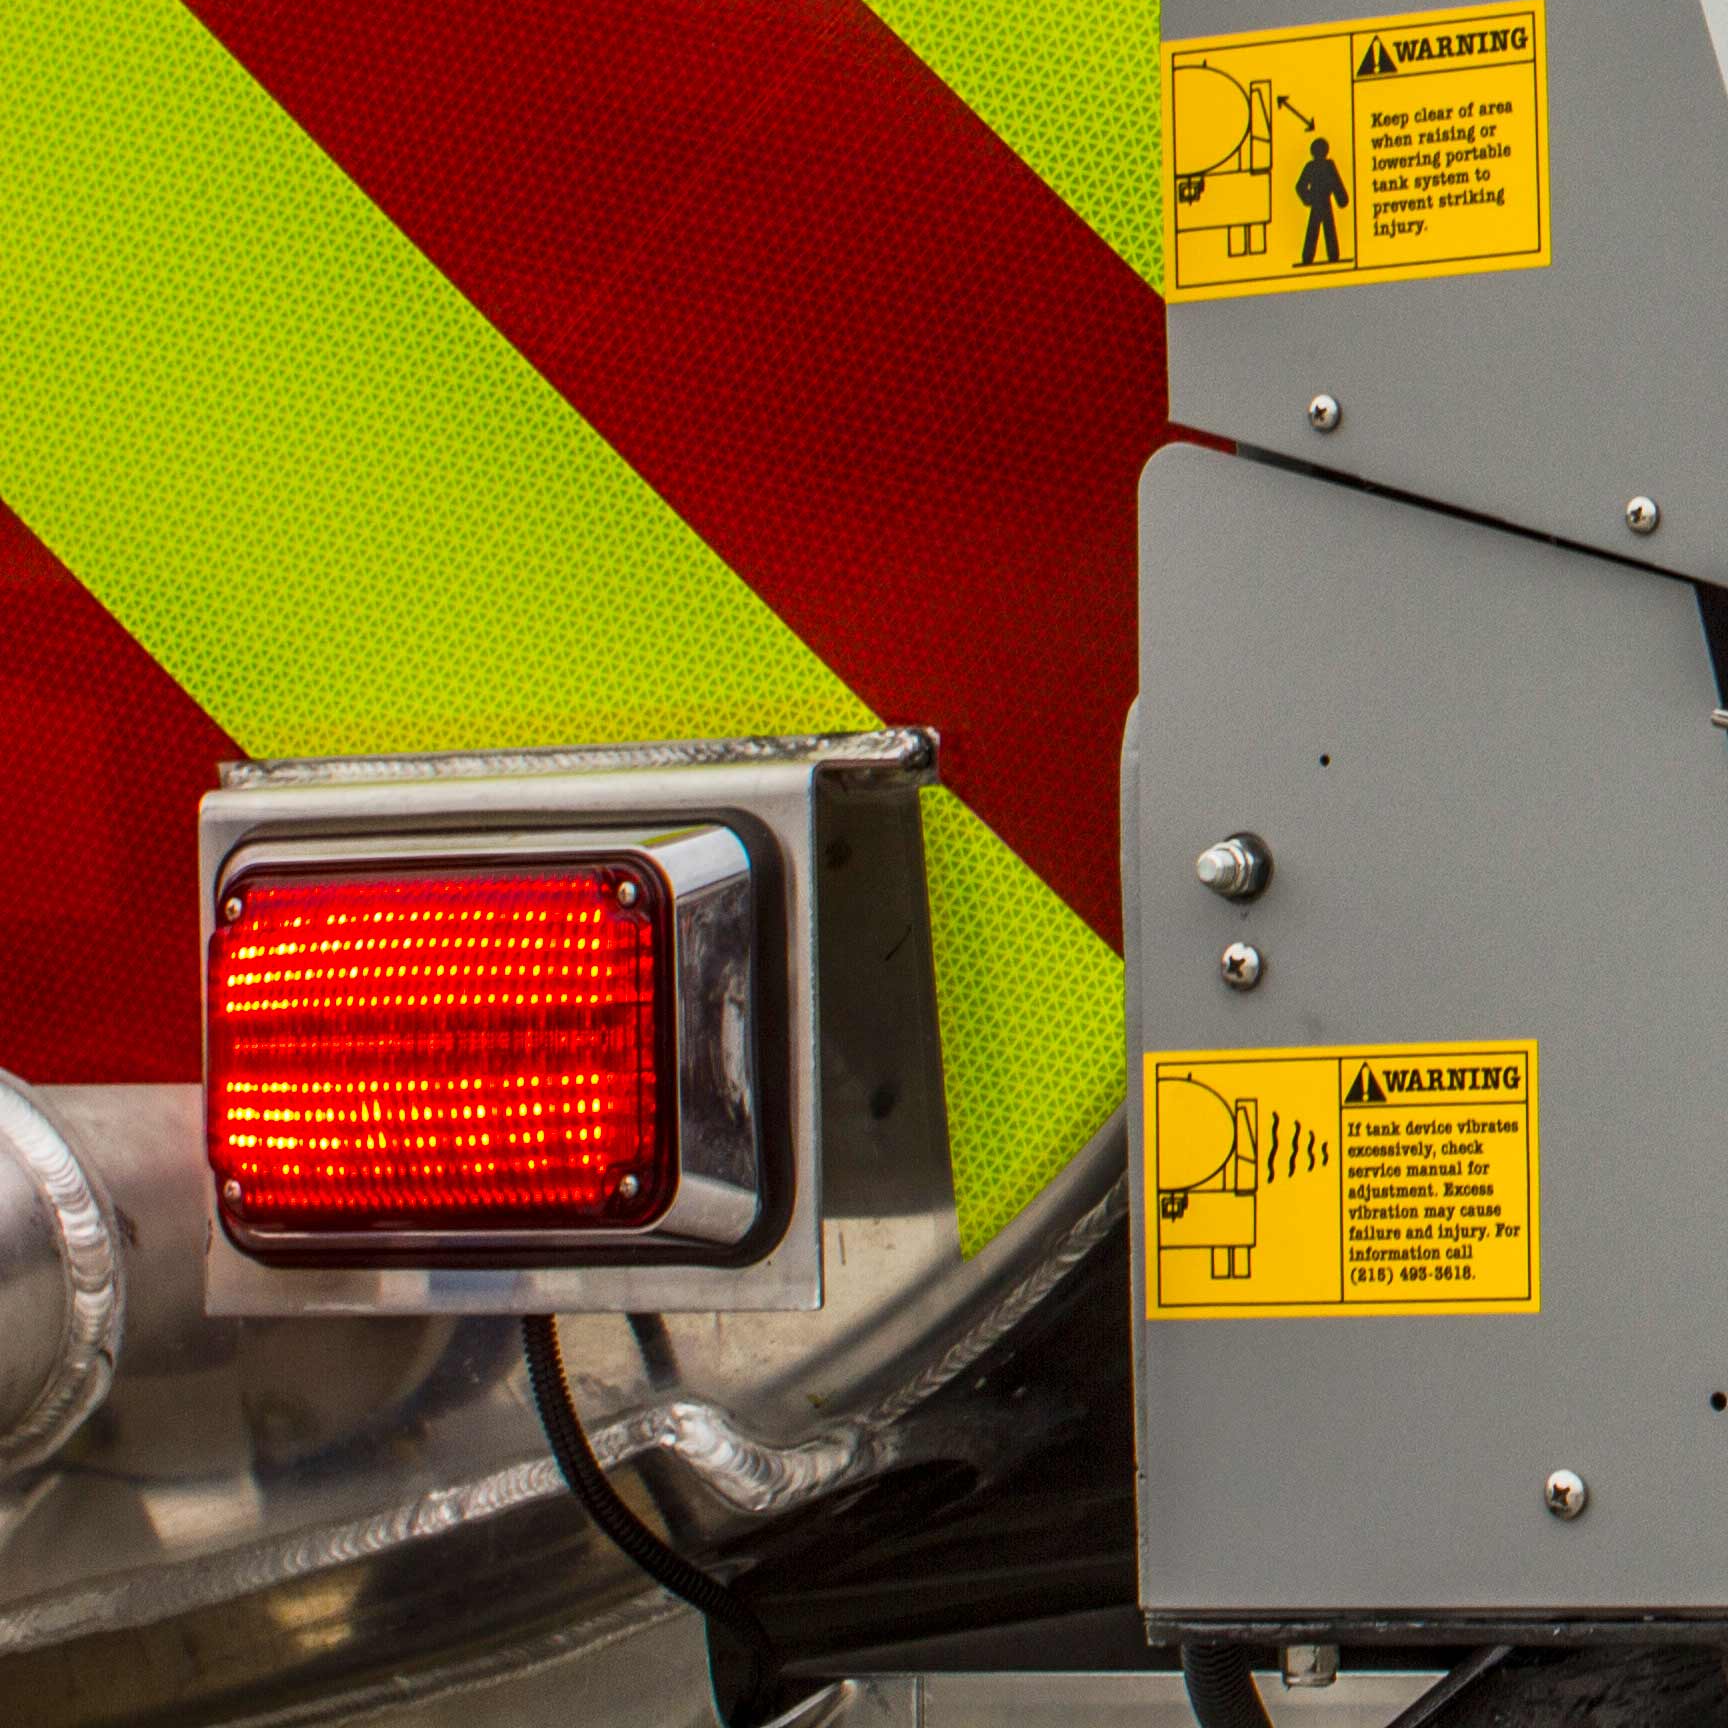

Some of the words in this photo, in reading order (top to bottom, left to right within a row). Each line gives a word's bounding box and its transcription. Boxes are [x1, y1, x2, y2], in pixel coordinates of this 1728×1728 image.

[1393, 27, 1529, 63] WARNING
[1371, 112, 1409, 129] Keep
[1414, 108, 1453, 123] clear
[1458, 102, 1474, 118] of
[1479, 101, 1512, 116] area
[1371, 134, 1412, 149] when
[1418, 126, 1475, 144] raising
[1480, 125, 1496, 137] or
[1372, 151, 1441, 171] lowering
[1446, 144, 1511, 167] portable
[1372, 176, 1408, 193] tank
[1414, 172, 1469, 191] system
[1475, 168, 1490, 181] to
[1373, 195, 1432, 219] prevent
[1439, 188, 1505, 208] striking
[1373, 220, 1428, 238] injury.
[1382, 1066, 1521, 1093] WARNING
[1347, 1122, 1361, 1137] If
[1365, 1122, 1399, 1137] tank
[1405, 1121, 1452, 1135] device
[1457, 1119, 1519, 1134] vibrates
[1347, 1142, 1436, 1159] excessively,
[1441, 1140, 1482, 1155] check
[1348, 1163, 1401, 1178] service
[1406, 1162, 1462, 1177] manual
[1468, 1160, 1489, 1175] for
[1348, 1184, 1438, 1202] adjustment.
[1443, 1182, 1494, 1197] Excess
[1348, 1205, 1418, 1220] vibration
[1424, 1206, 1455, 1222] may
[1460, 1205, 1501, 1217] cause
[1349, 1226, 1401, 1241] failure
[1405, 1225, 1433, 1240] and
[1438, 1224, 1490, 1242] injury.
[1495, 1223, 1520, 1237] For
[1349, 1246, 1440, 1262] information
[1445, 1245, 1472, 1260] call
[1350, 1267, 1395, 1285] (215)
